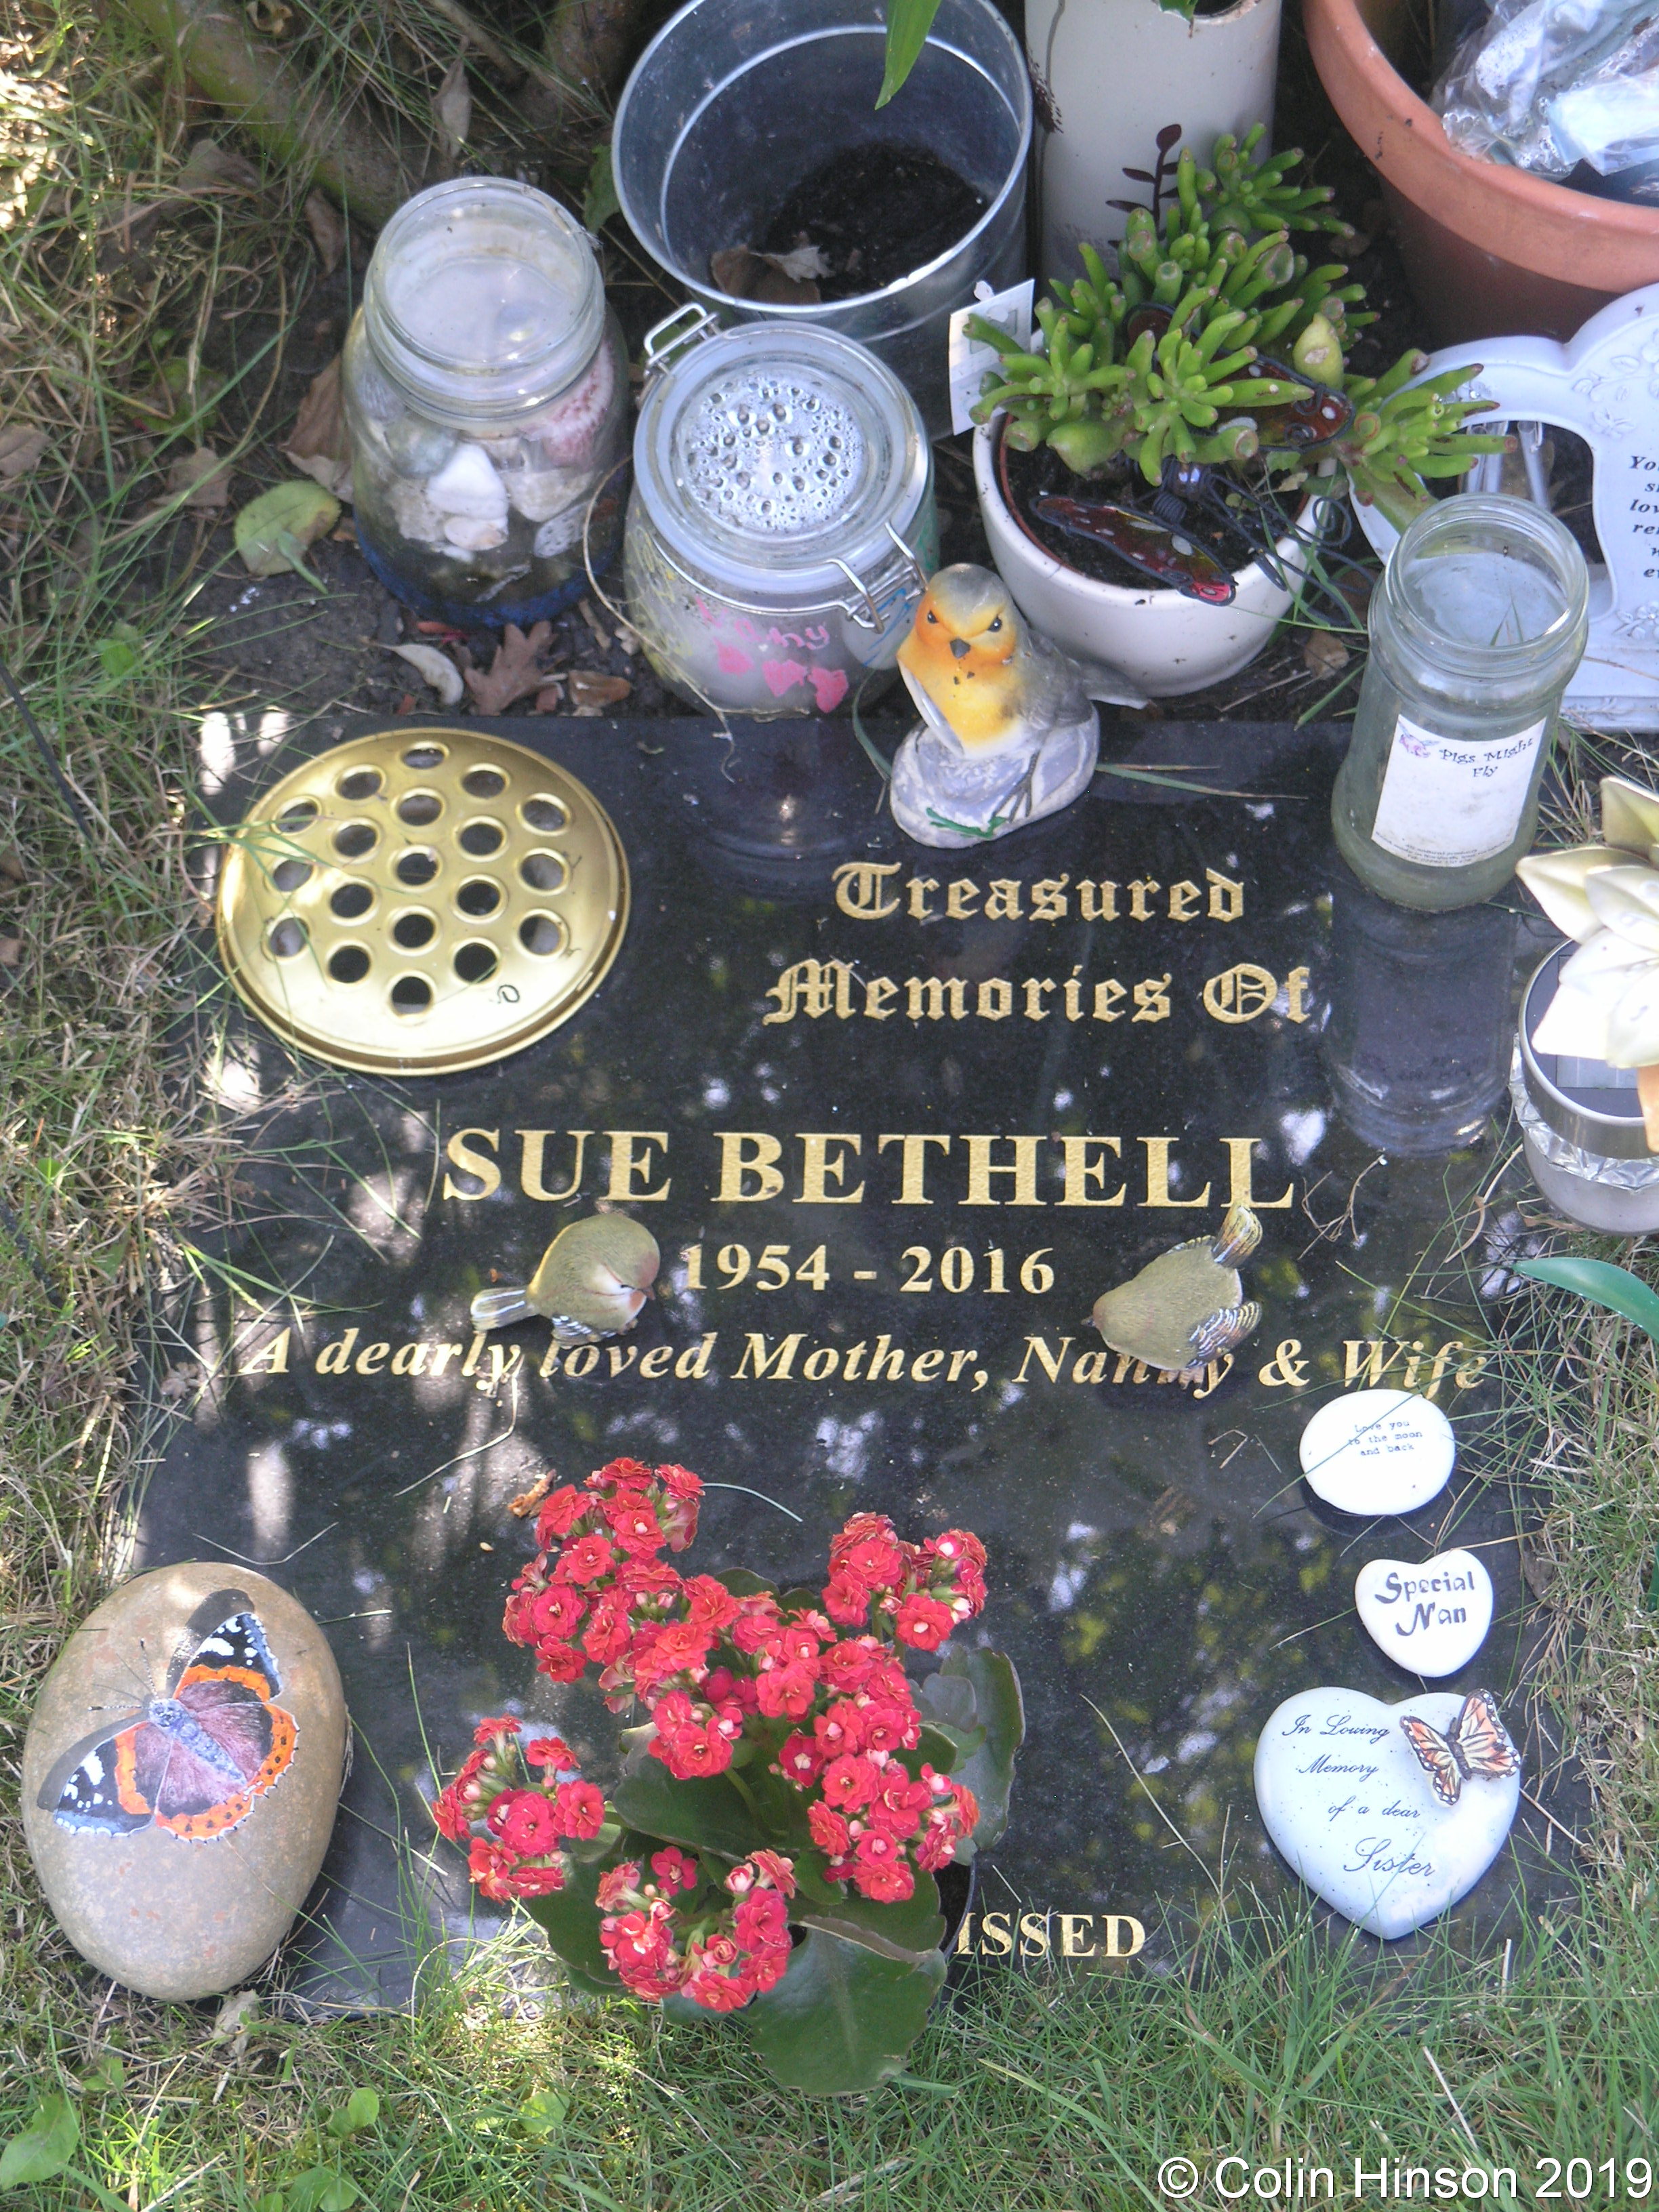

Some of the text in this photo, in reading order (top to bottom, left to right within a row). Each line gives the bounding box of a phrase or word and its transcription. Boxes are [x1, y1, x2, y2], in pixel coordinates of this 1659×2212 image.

[1629, 455, 1659, 471] Yo
[1439, 738, 1533, 764] Pigs Might
[1473, 766, 1498, 777] Fly
[831, 861, 1245, 923] Treasured
[762, 958, 1311, 1026] Memories Of
[443, 1128, 1294, 1209] SUE BETHELL
[679, 1244, 830, 1291] 1954
[899, 1246, 1054, 1294] 2016
[239, 1326, 1488, 1400] A dearly loved Mother, Nany & Wife
[1354, 1420, 1410, 1433] Love you
[1368, 1435, 1387, 1443] the
[1395, 1431, 1423, 1440] moon
[1360, 1443, 1414, 1456] and back
[1374, 1571, 1475, 1604] Special
[1395, 1601, 1467, 1637] Nan
[1282, 1714, 1390, 1744] In Loving
[1298, 1753, 1379, 1782] Memory
[1328, 1795, 1420, 1822] of a dear
[1343, 1837, 1436, 1877] Sister
[952, 1912, 1146, 1957] ISSED
